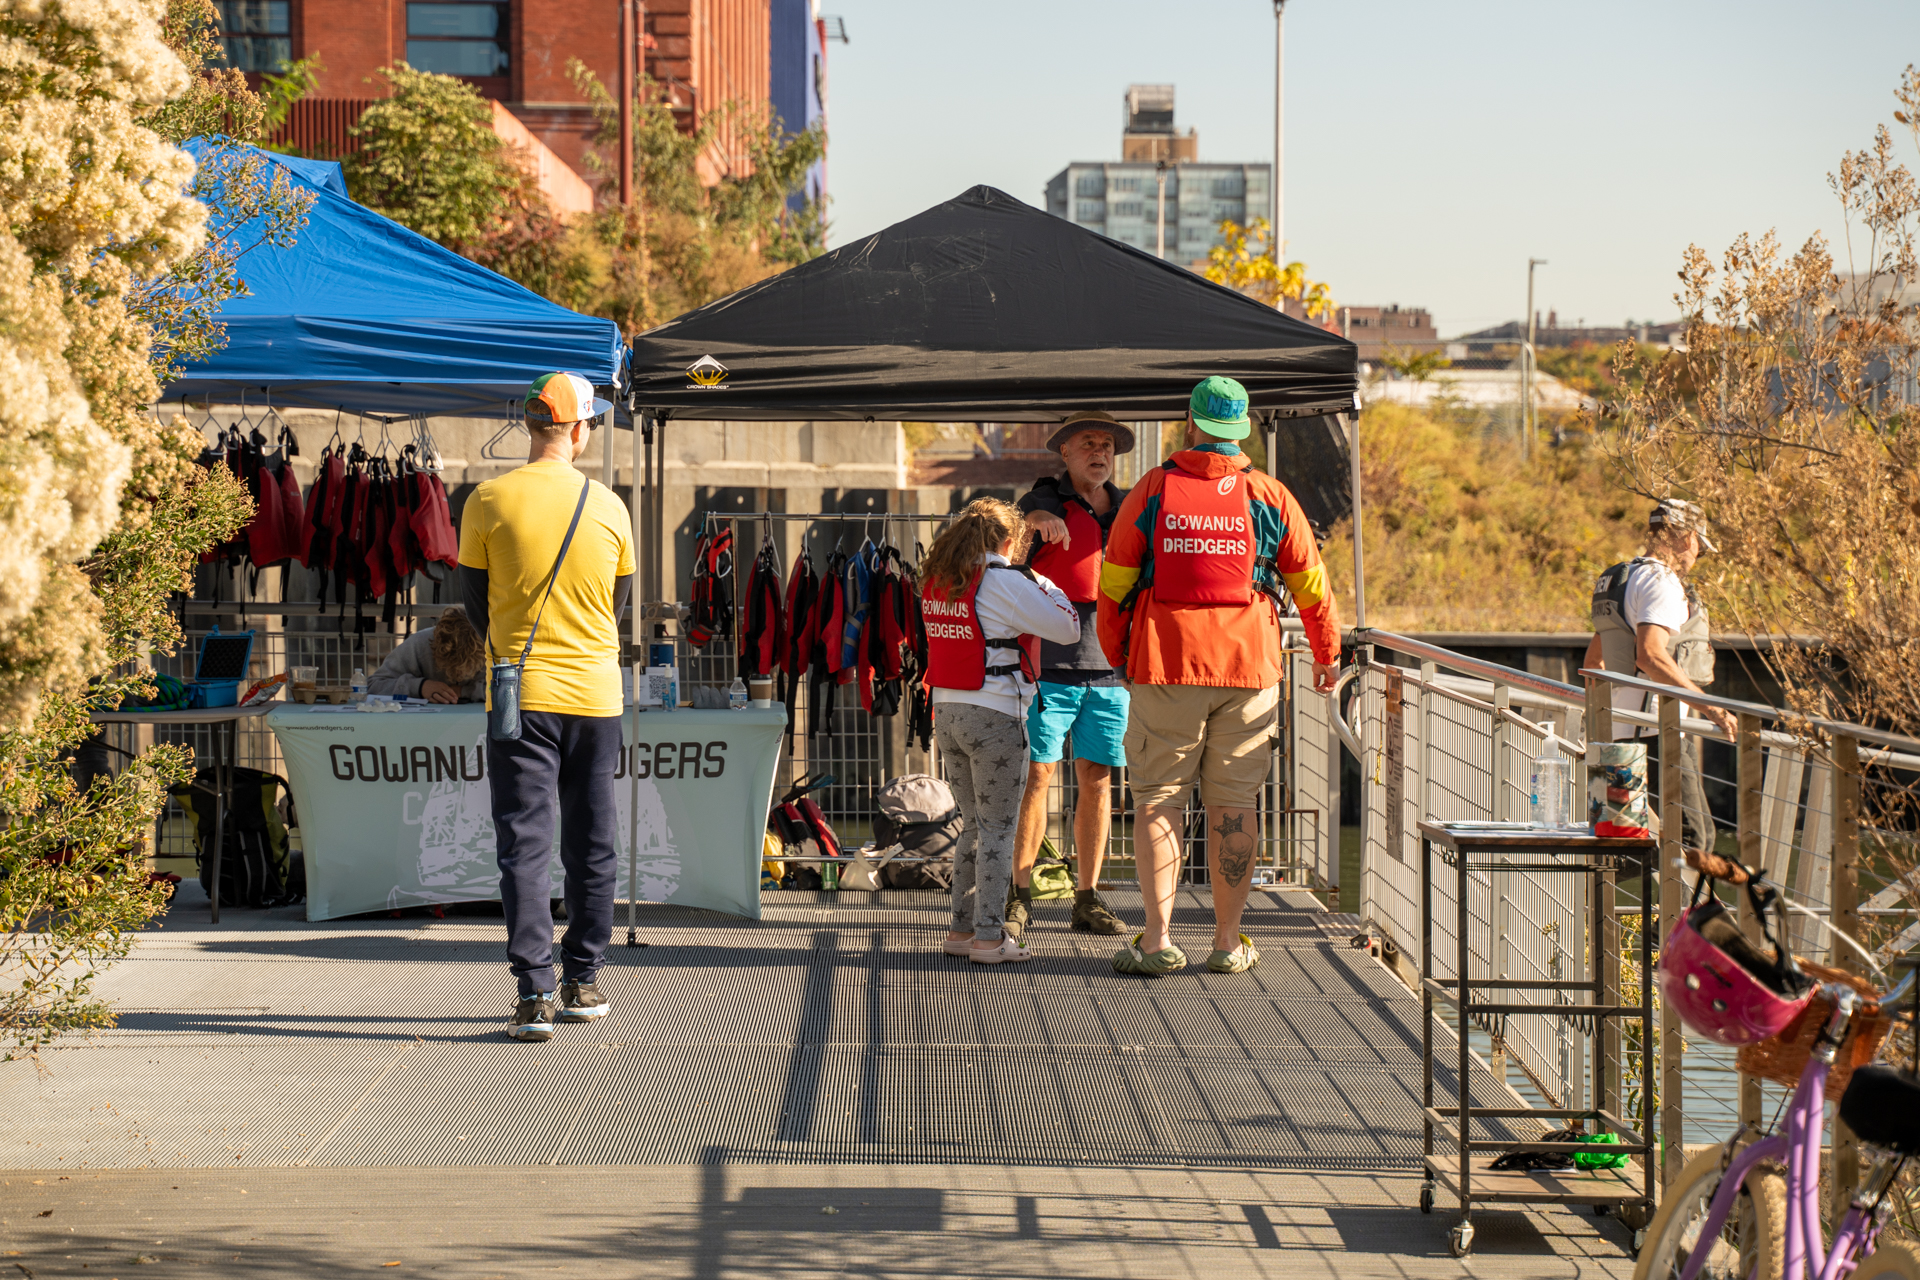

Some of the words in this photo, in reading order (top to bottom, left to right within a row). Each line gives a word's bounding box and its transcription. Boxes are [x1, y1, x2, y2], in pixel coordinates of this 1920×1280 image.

[1165, 514, 1245, 533] GOWANUS
[1163, 538, 1247, 555] DREDGERS
[922, 599, 970, 618] GOWANUS
[328, 744, 489, 783] GOWANU
